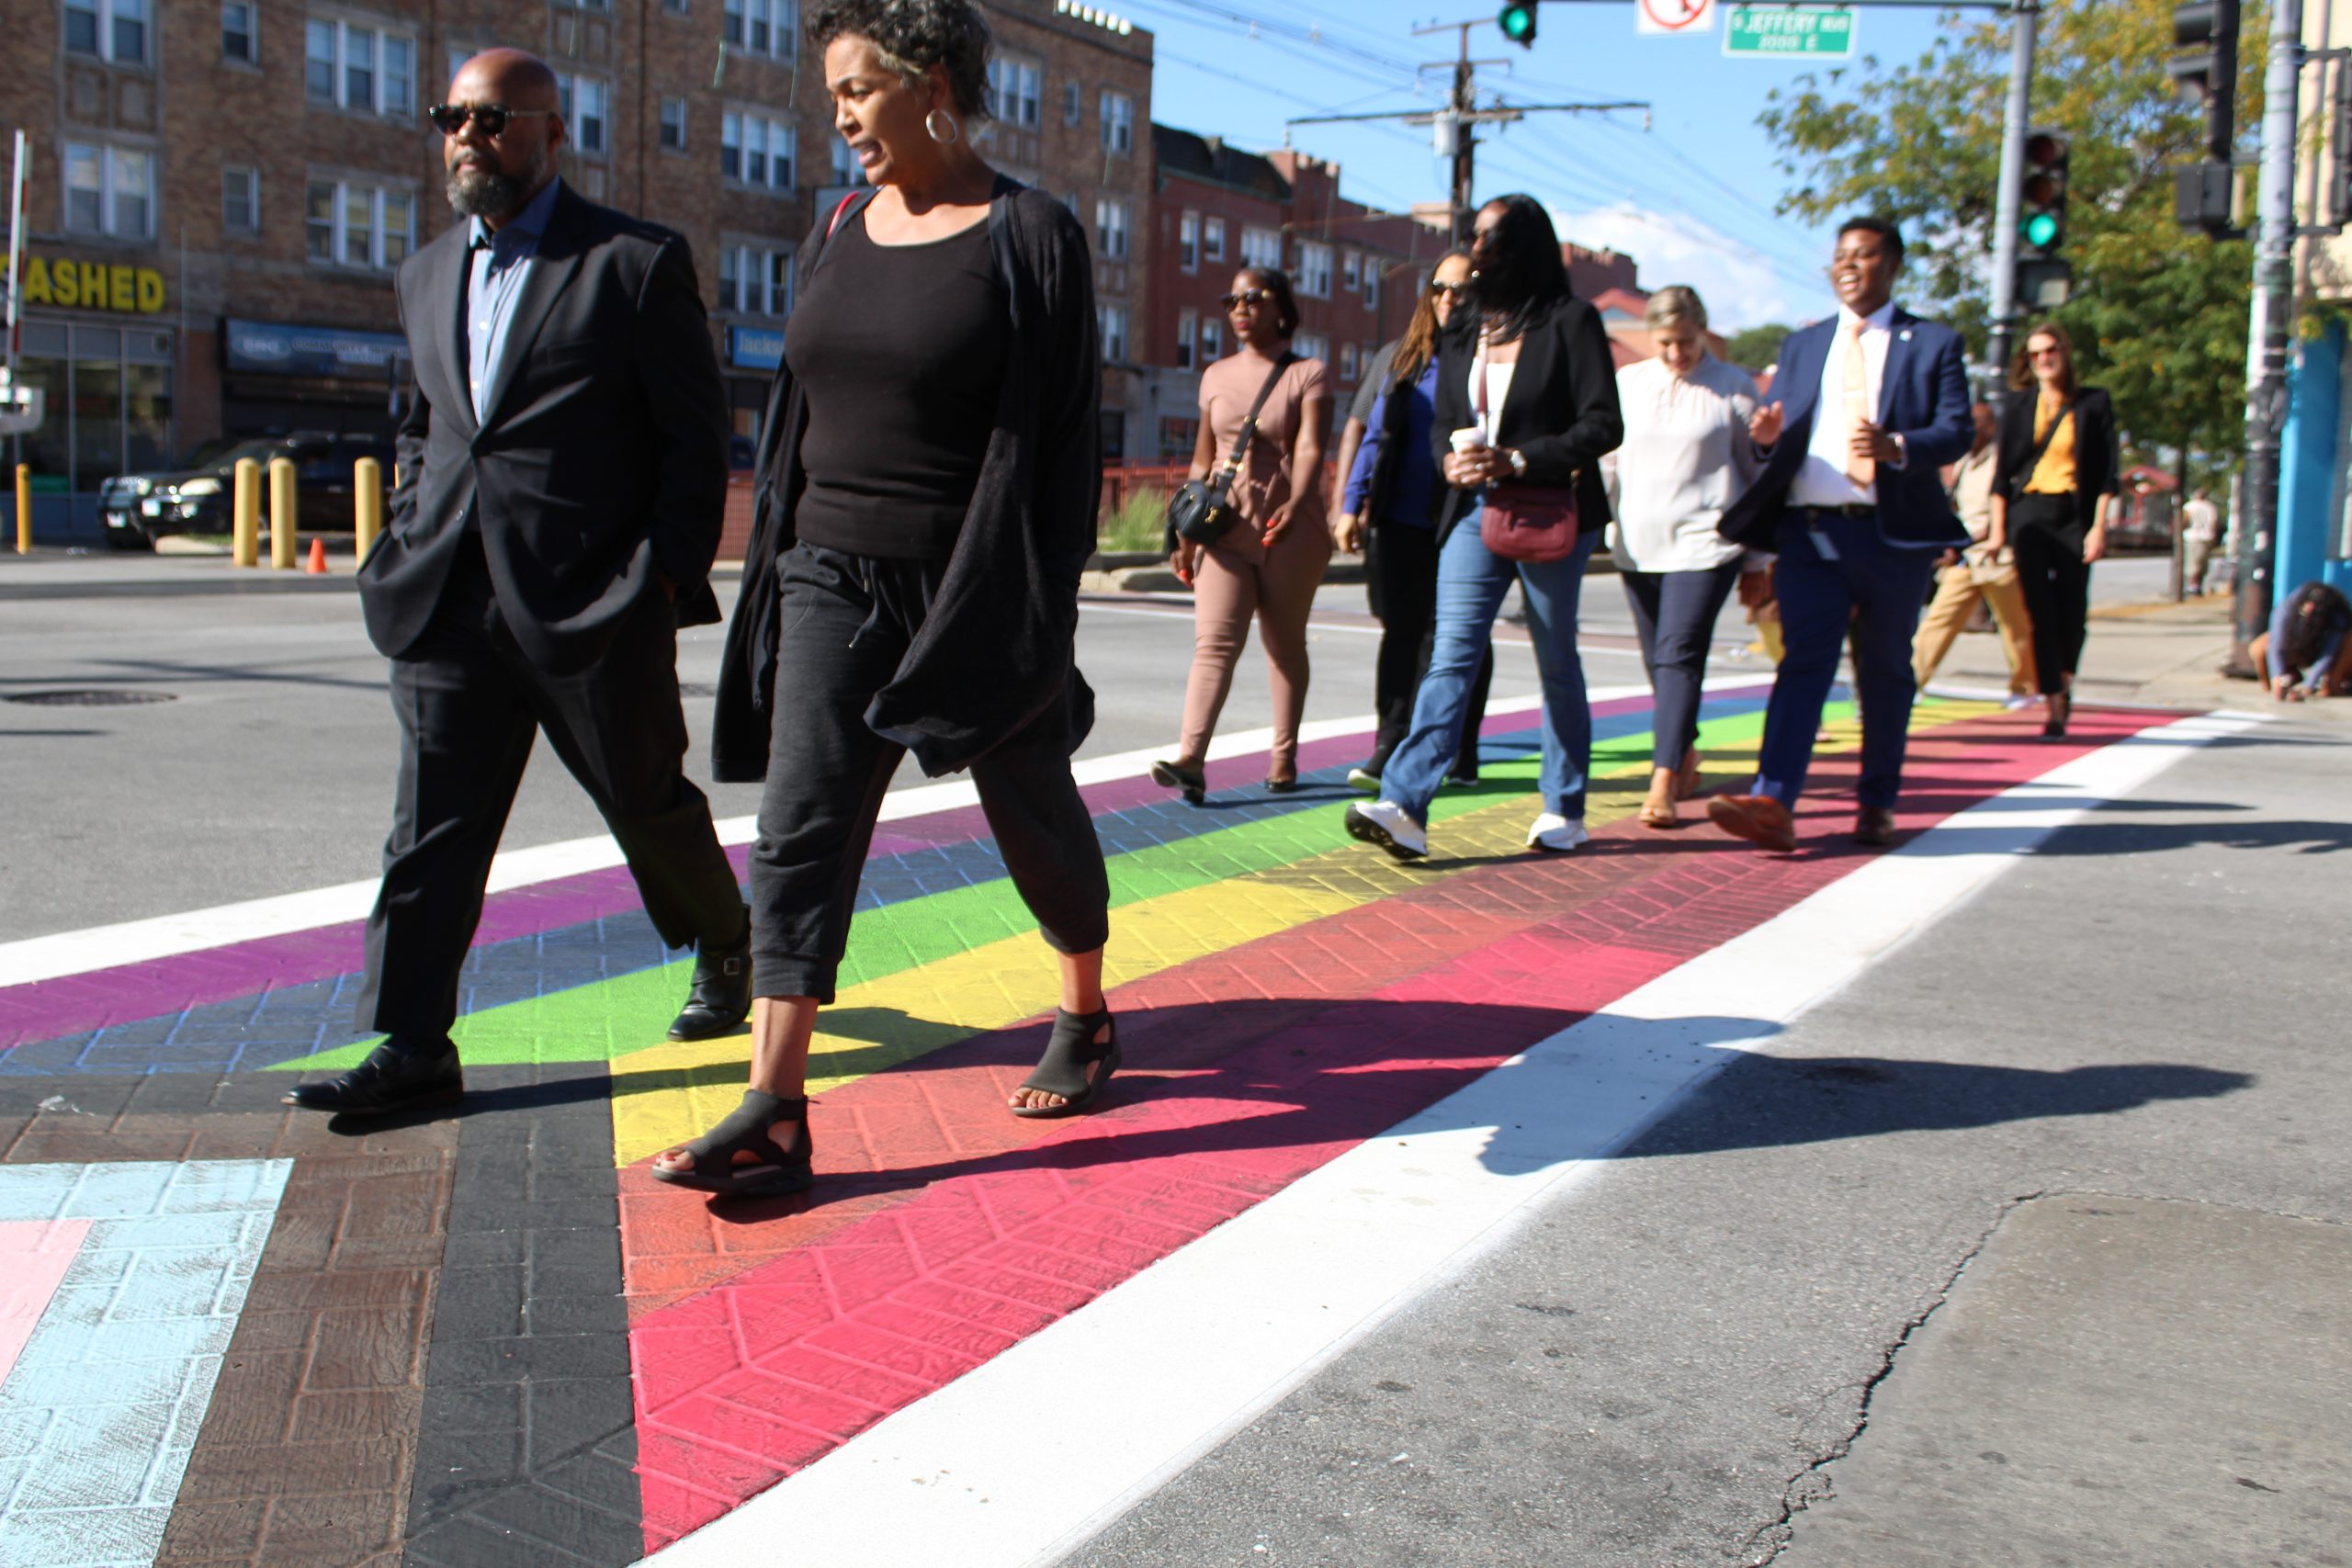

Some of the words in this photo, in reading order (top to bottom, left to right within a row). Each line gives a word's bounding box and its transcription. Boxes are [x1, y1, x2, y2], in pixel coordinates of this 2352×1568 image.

[1745, 13, 1817, 33] JEFFERY
[0, 254, 165, 314] ASHED
[738, 331, 785, 357] Jacks
